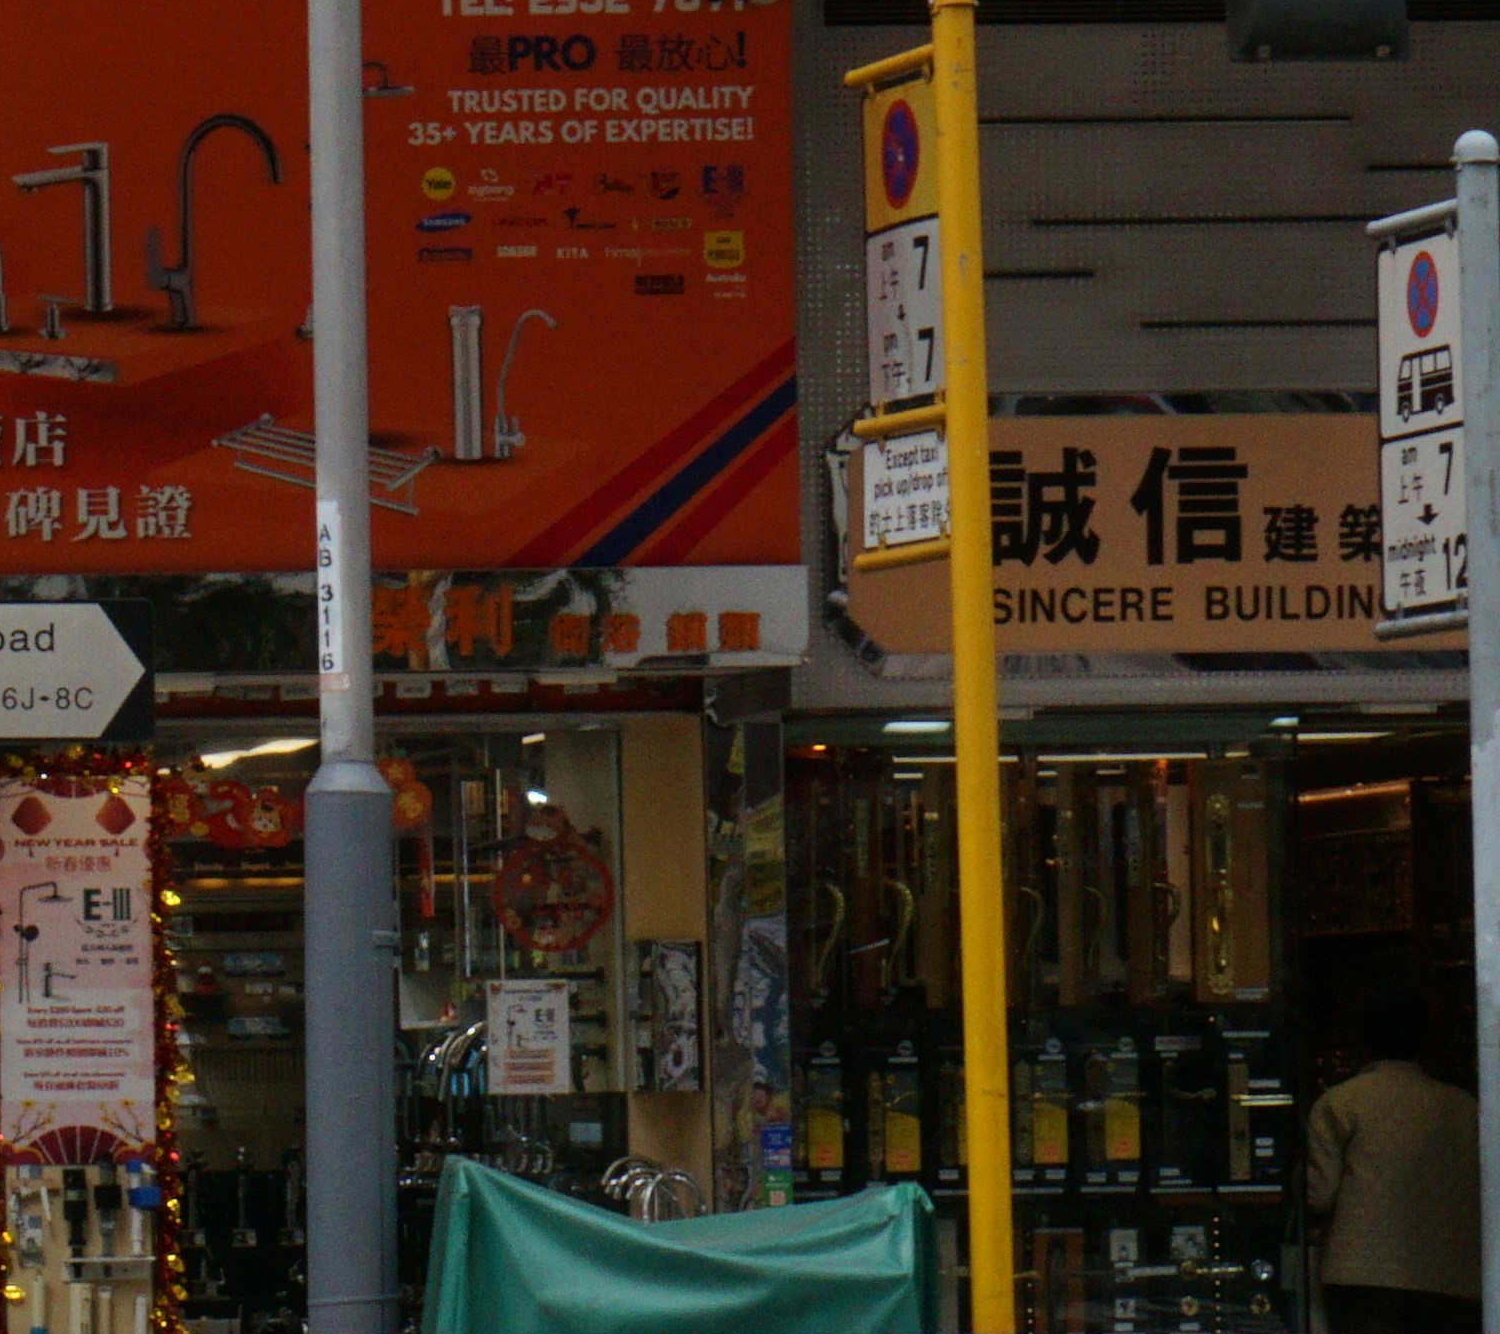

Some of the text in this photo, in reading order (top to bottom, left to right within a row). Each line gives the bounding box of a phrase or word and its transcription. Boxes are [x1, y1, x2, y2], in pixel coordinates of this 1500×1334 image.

[447, 85, 755, 115] TRUSTED FOR QUALITY
[407, 116, 755, 147] 35+ YEARS OF EXPERTISE!
[912, 234, 929, 291] 7
[917, 327, 934, 382] 7
[1438, 441, 1453, 496] 7
[989, 446, 1248, 566] 誠信
[1443, 533, 1468, 590] 12
[991, 586, 1174, 625] SINCERE
